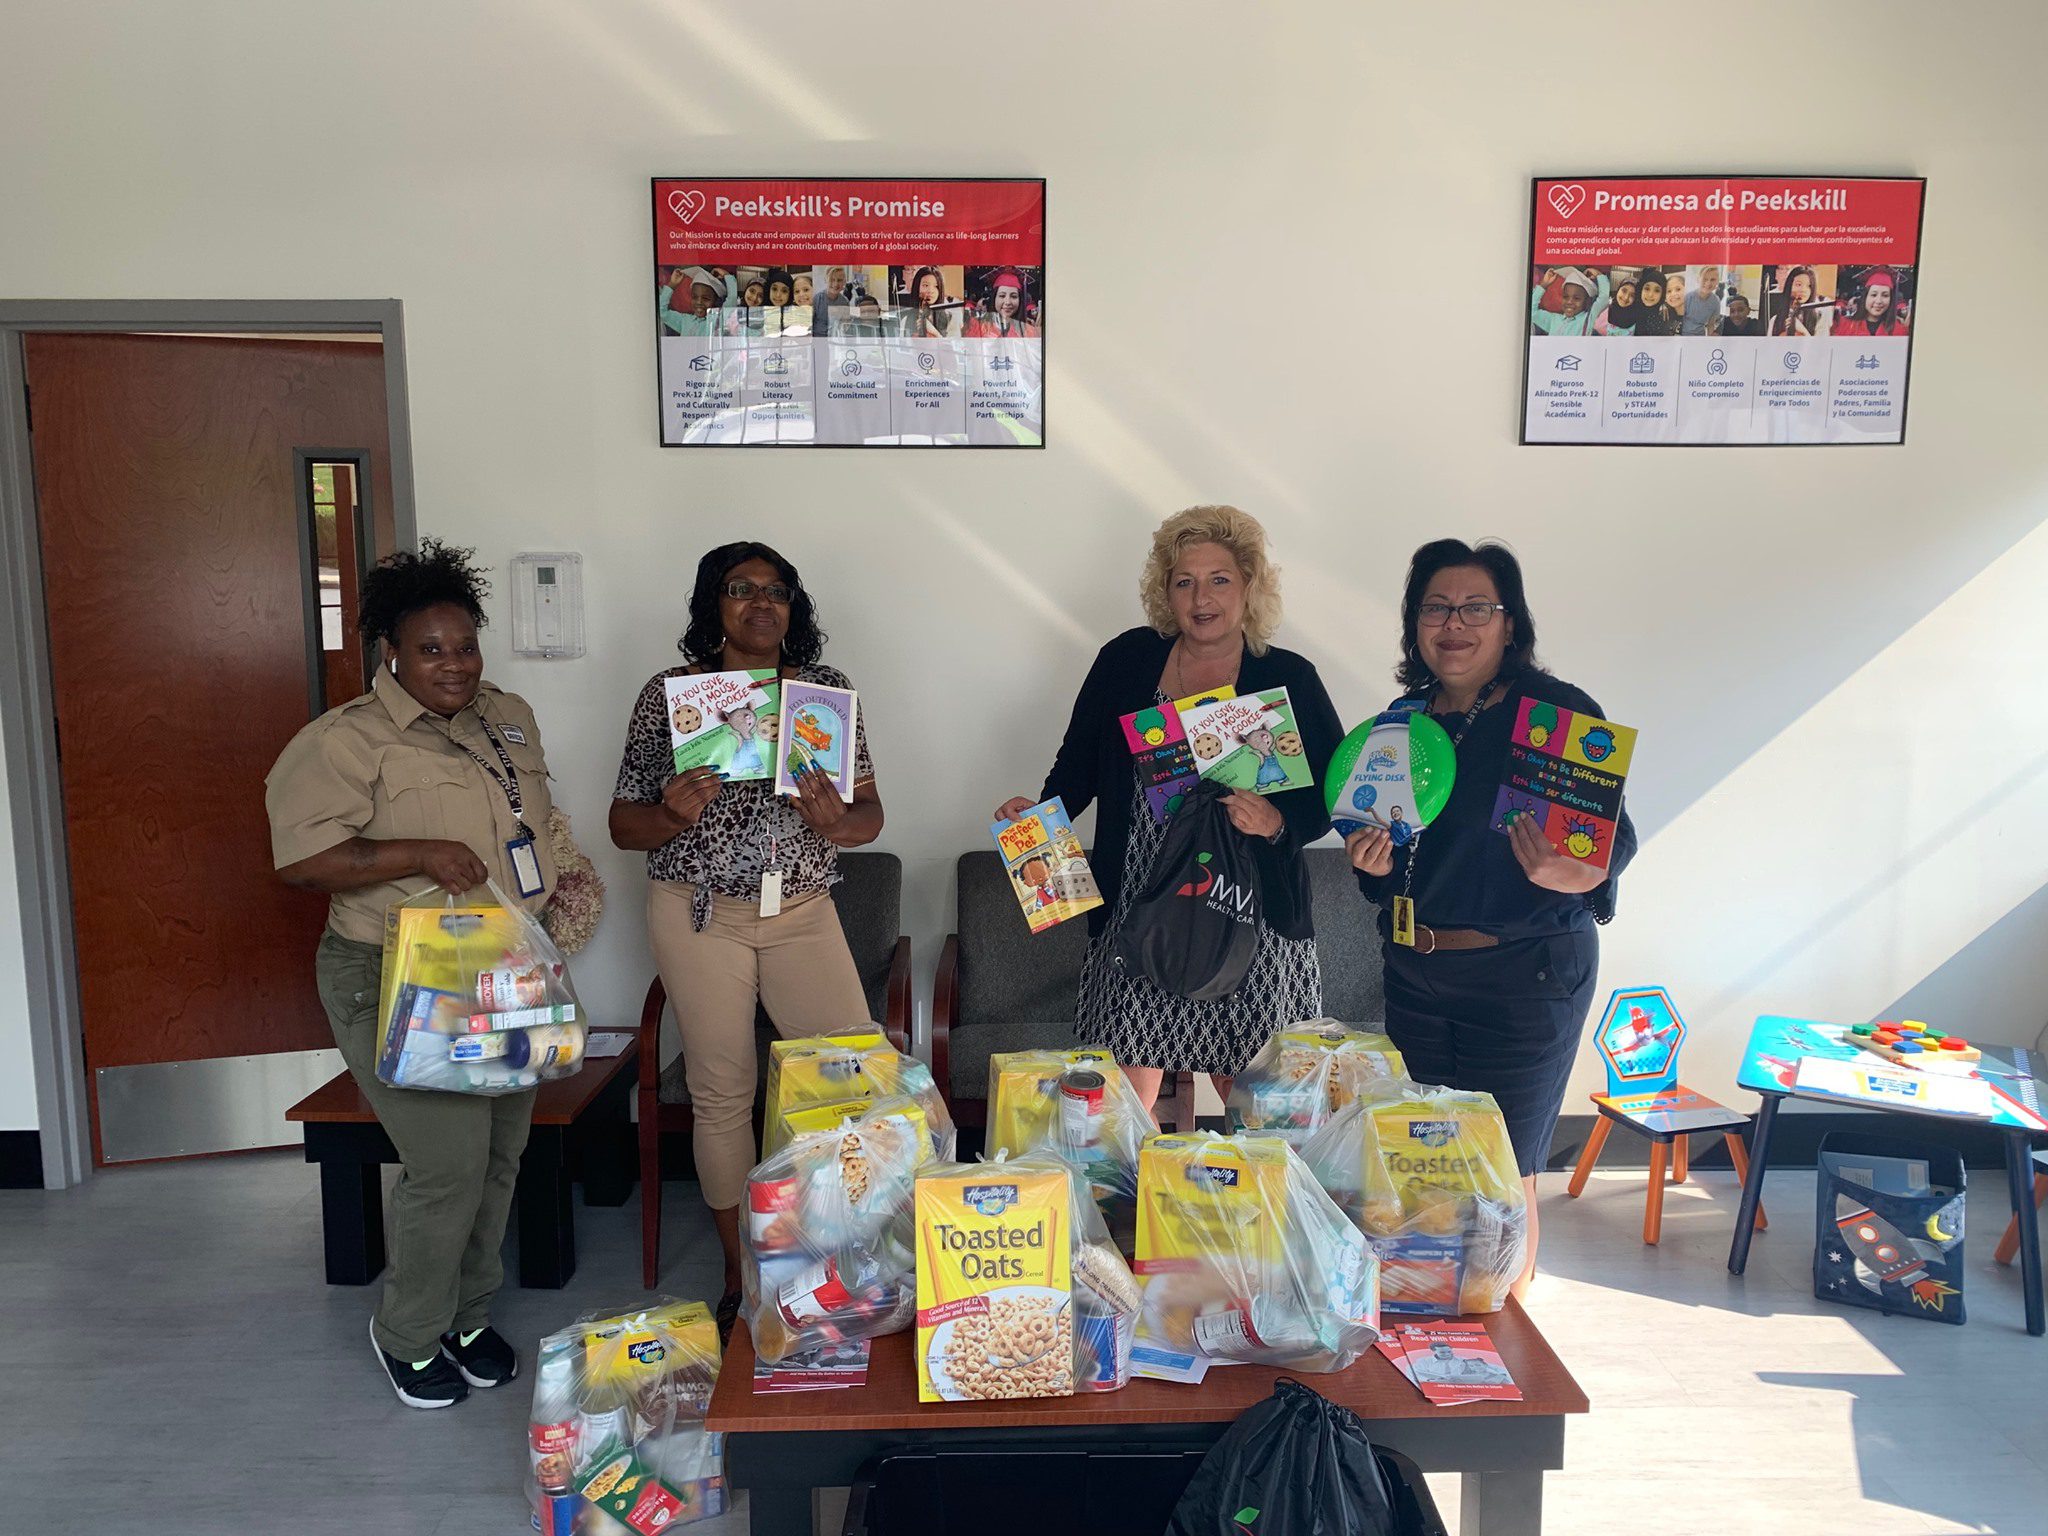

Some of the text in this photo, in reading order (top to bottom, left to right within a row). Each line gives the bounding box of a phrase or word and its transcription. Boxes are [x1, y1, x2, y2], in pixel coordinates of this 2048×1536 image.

[1594, 189, 1847, 211] Promesa de Peekskill
[848, 195, 945, 217] Promise
[1670, 226, 1693, 234] poder
[669, 231, 1019, 241] Our Mission is to educate and empower all students to strive for excellence as life-long learners
[1569, 236, 1610, 245] aprendices
[1637, 236, 1653, 244] vida
[1670, 236, 1700, 244] abrazan
[1710, 236, 1750, 244] diversidad
[1788, 236, 1825, 244] miembros
[1826, 236, 1883, 245] contribuyentes
[670, 242, 686, 250] who
[688, 242, 720, 250] embrace
[722, 242, 754, 252] diversity
[756, 242, 770, 250] and
[785, 242, 832, 252] contributing
[834, 242, 868, 250] members
[870, 242, 878, 250] of
[886, 242, 908, 252] global
[910, 242, 939, 252] society.
[1596, 247, 1622, 256] global.
[983, 380, 1017, 388] Powerful
[1550, 380, 1584, 388] Riguroso
[1688, 380, 1744, 389] Niño Completo
[762, 391, 793, 400] Literacy
[973, 390, 1027, 399] Parent, Family
[1618, 390, 1664, 398] Alfabetismo
[1692, 390, 1740, 398] Compromiso
[1759, 390, 1822, 398] Enriquecimiento
[692, 402, 730, 410] Culturally
[986, 401, 1030, 410] Community
[1550, 400, 1582, 408] Sensible
[1631, 400, 1656, 408] STEAM
[1834, 400, 1862, 408] Padres,
[752, 412, 805, 420] Opportunities
[1545, 410, 1586, 418] Académica
[1612, 411, 1668, 419] Oportunidades
[671, 674, 725, 708] IF YOU GIVE
[700, 680, 738, 708] A MOUSE
[706, 686, 750, 716] A COOKIE
[789, 695, 848, 722] FOX OUTFOXED
[1466, 698, 1484, 726] STAFF
[1188, 702, 1236, 738] IF YOU GIVE
[1216, 706, 1252, 734] A MOUSE
[1224, 712, 1263, 740] A COOKIE
[496, 746, 512, 768] STAFF
[1156, 748, 1176, 758] Okay
[1172, 766, 1188, 776] bien
[1527, 750, 1547, 769] Okay
[1548, 760, 1558, 770] to
[1560, 763, 1570, 775] Be
[1572, 767, 1618, 789] Different
[1354, 774, 1406, 782] FLYING DISK
[1530, 780, 1544, 793] bien
[1546, 788, 1559, 798] ser
[1561, 791, 1604, 812] diferente
[1000, 817, 1039, 848] Perfect
[1015, 834, 1037, 854] Pet
[1206, 900, 1235, 918] HEALTH
[1384, 1150, 1481, 1174] Toasted
[967, 1186, 1015, 1202] Hospitality
[934, 1221, 1044, 1250] Toasted
[961, 1252, 1044, 1280] Oats Cereal
[1084, 1268, 1100, 1284] LONG
[1101, 1281, 1116, 1298] GRAIN
[928, 1298, 980, 1317] Good Source 12
[928, 1305, 988, 1324] Vitamins and Minerals
